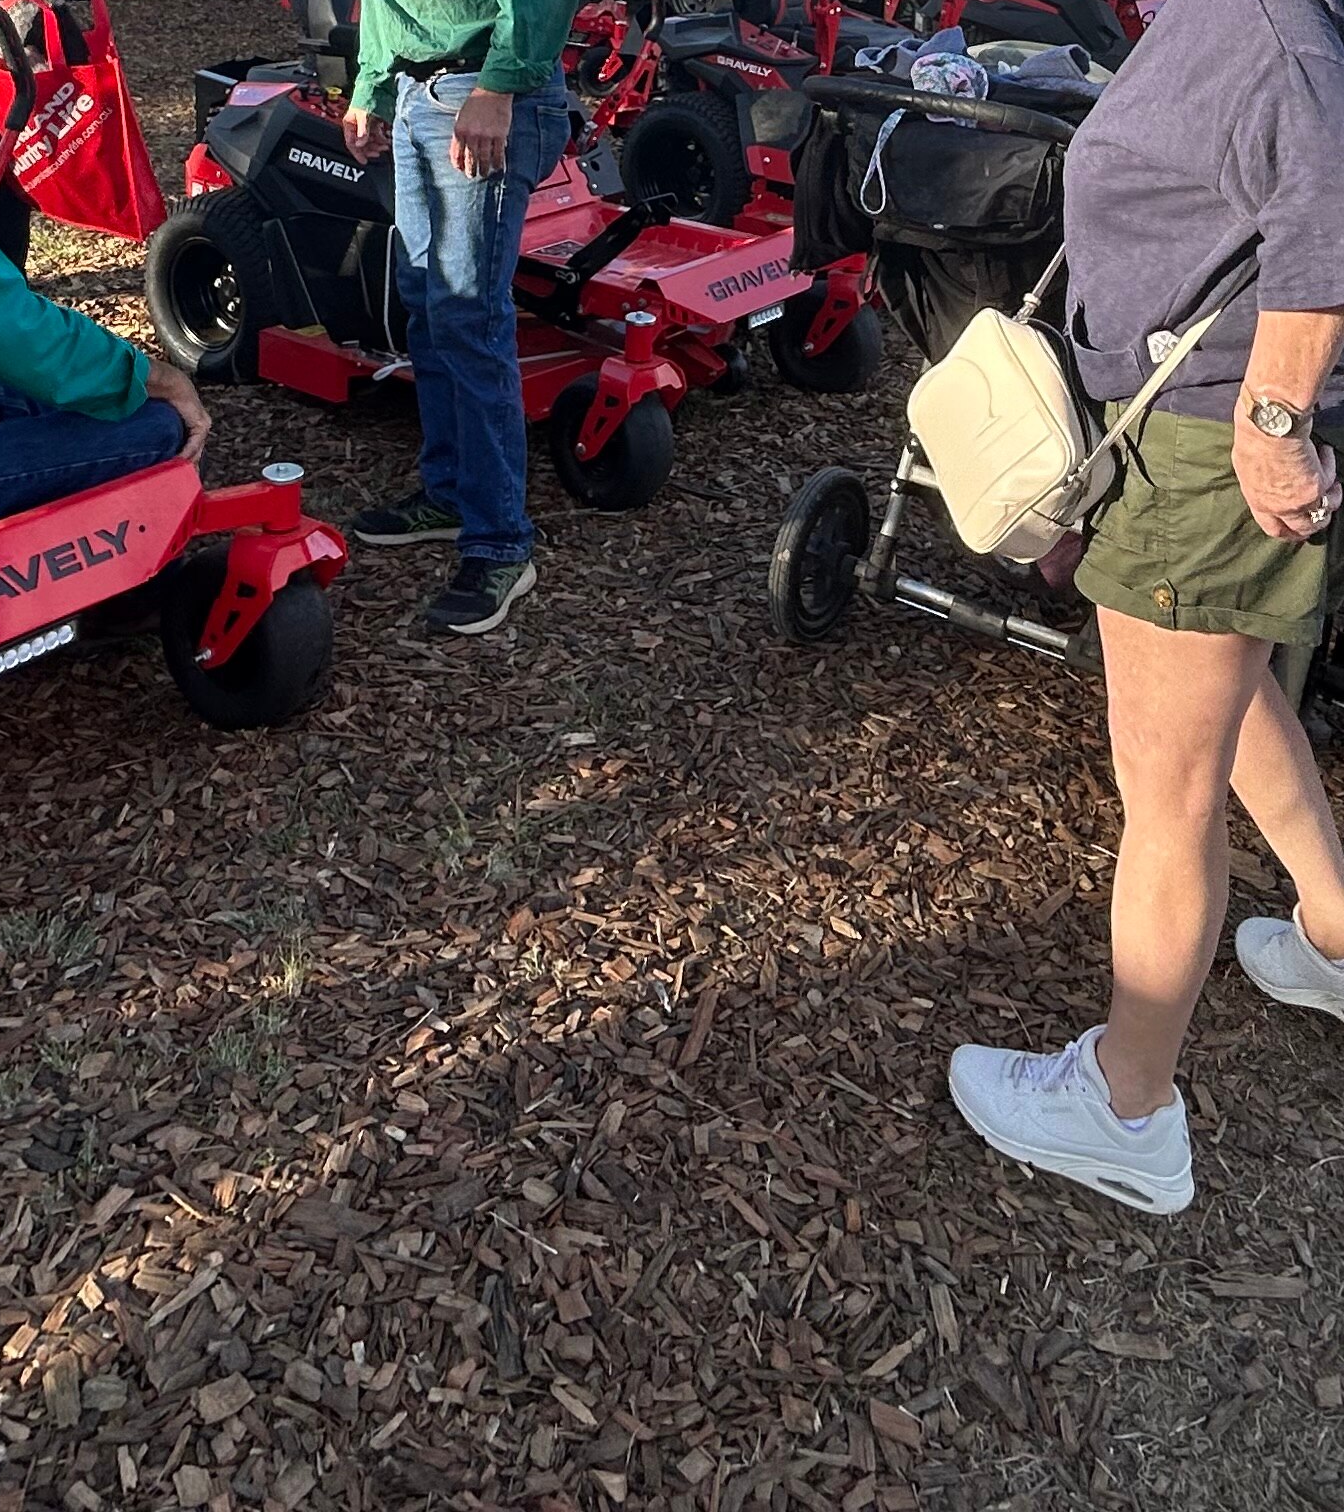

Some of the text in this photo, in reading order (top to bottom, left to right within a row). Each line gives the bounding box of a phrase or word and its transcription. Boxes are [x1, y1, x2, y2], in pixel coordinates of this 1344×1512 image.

[716, 55, 773, 77] GRAVELY
[46, 93, 95, 140] Life
[288, 146, 366, 183] GRAVELY
